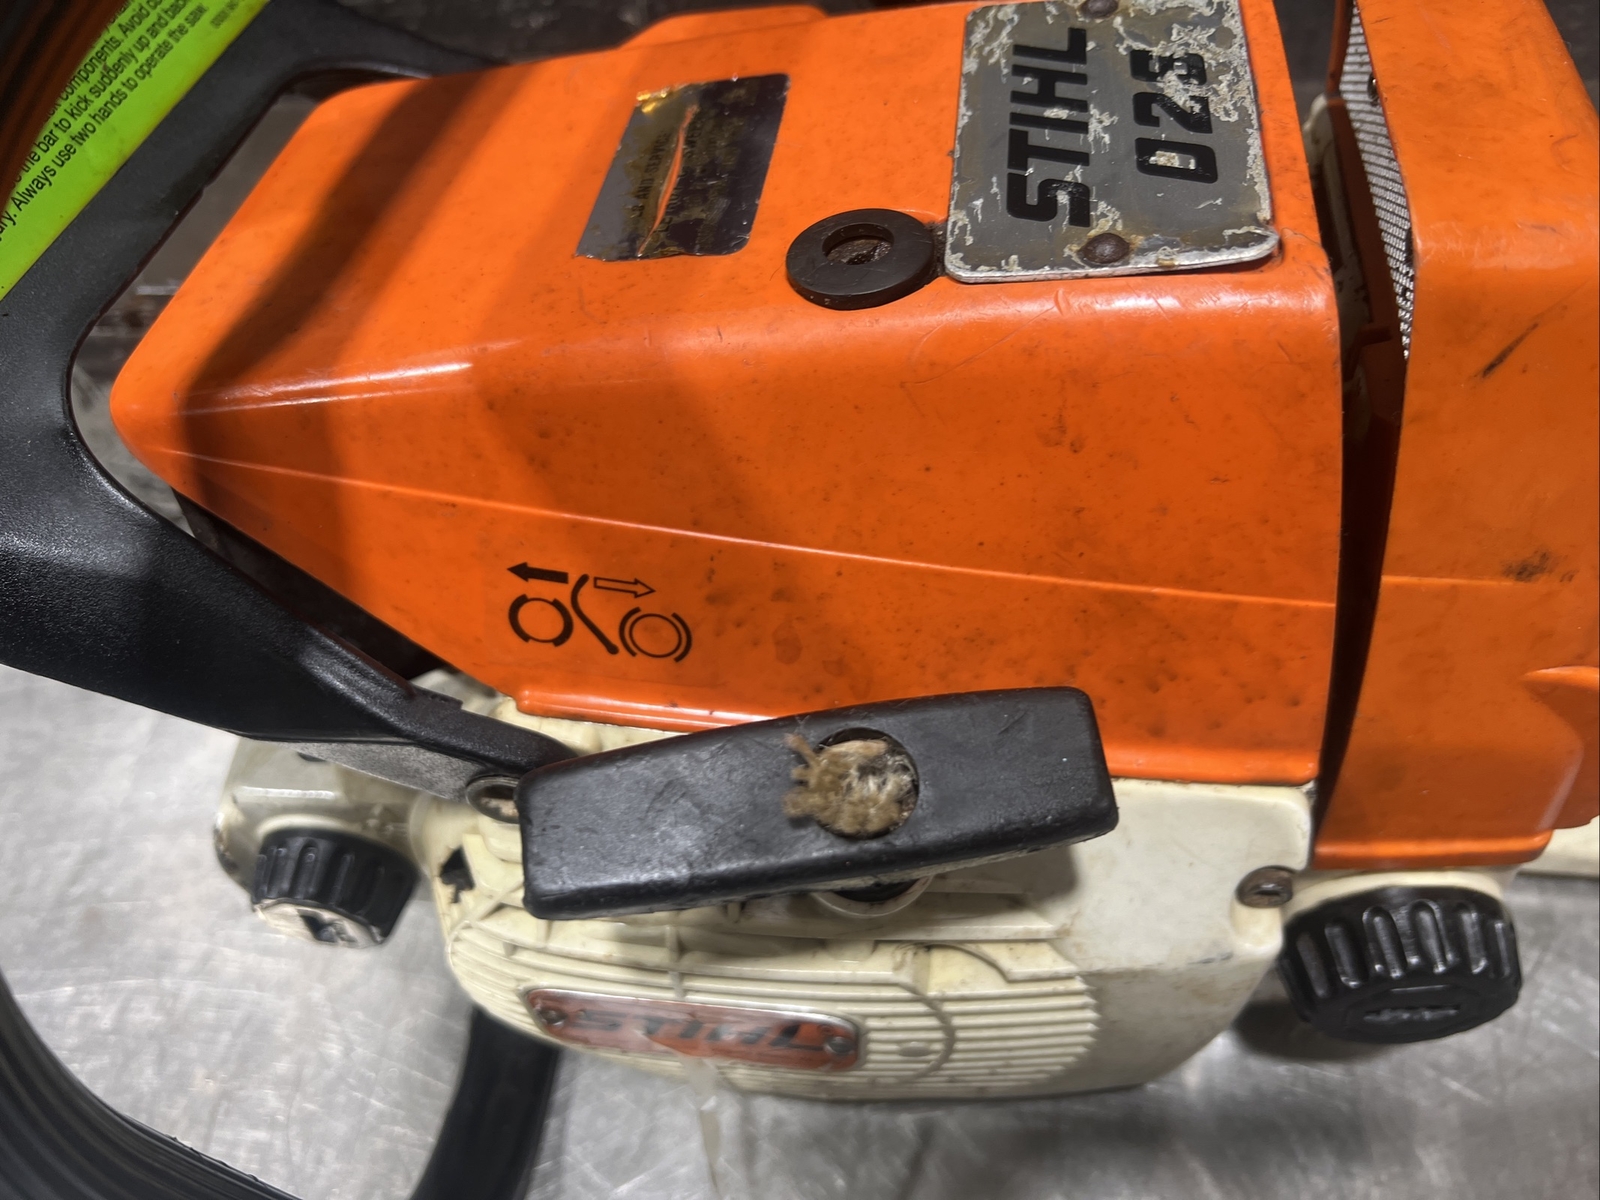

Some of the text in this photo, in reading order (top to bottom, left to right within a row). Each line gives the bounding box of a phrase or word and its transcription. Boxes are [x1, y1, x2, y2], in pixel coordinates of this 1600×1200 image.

[35, 128, 60, 154] bar
[53, 117, 72, 133] to
[63, 94, 94, 121] kick
[89, 48, 139, 99] suddenly
[132, 34, 151, 54] up
[146, 12, 169, 39] and
[118, 3, 150, 39] Avoid
[11, 164, 57, 211] Always
[51, 143, 77, 168] use
[70, 121, 97, 146] two
[88, 88, 128, 126] hands
[121, 77, 138, 92] to
[134, 38, 174, 78] operate
[168, 22, 189, 43] the
[1007, 27, 1091, 228] STIHL
